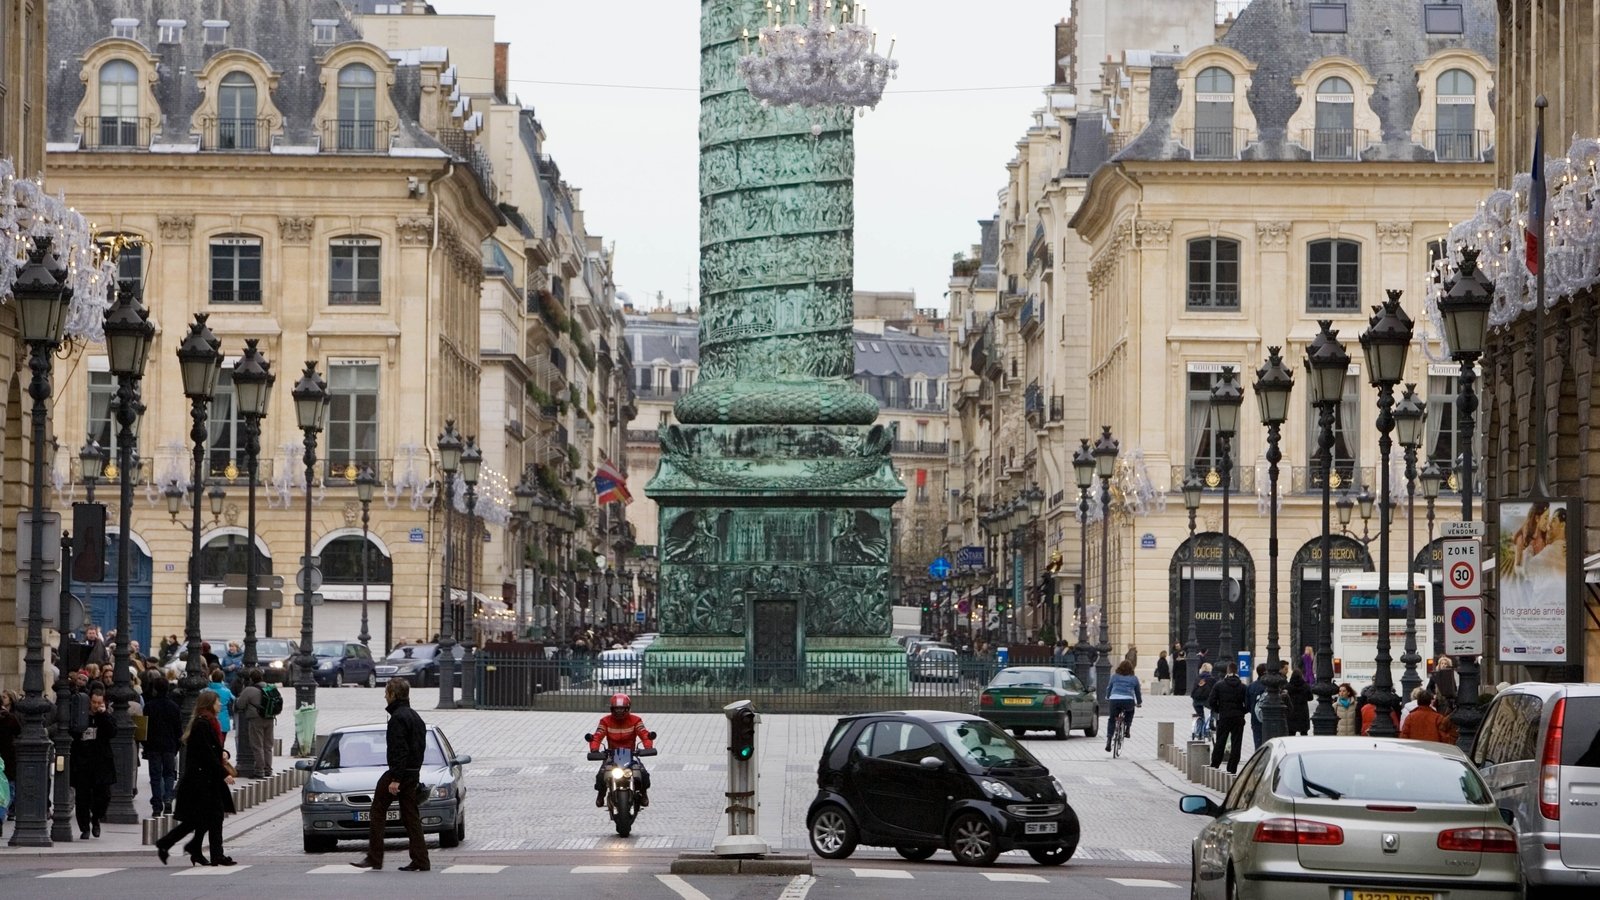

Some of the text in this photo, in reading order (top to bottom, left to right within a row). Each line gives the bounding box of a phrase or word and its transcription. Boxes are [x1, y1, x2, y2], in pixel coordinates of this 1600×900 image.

[1448, 547, 1474, 556] ZONE
[1455, 569, 1469, 581] 30
[1502, 606, 1566, 618] Une grande année
